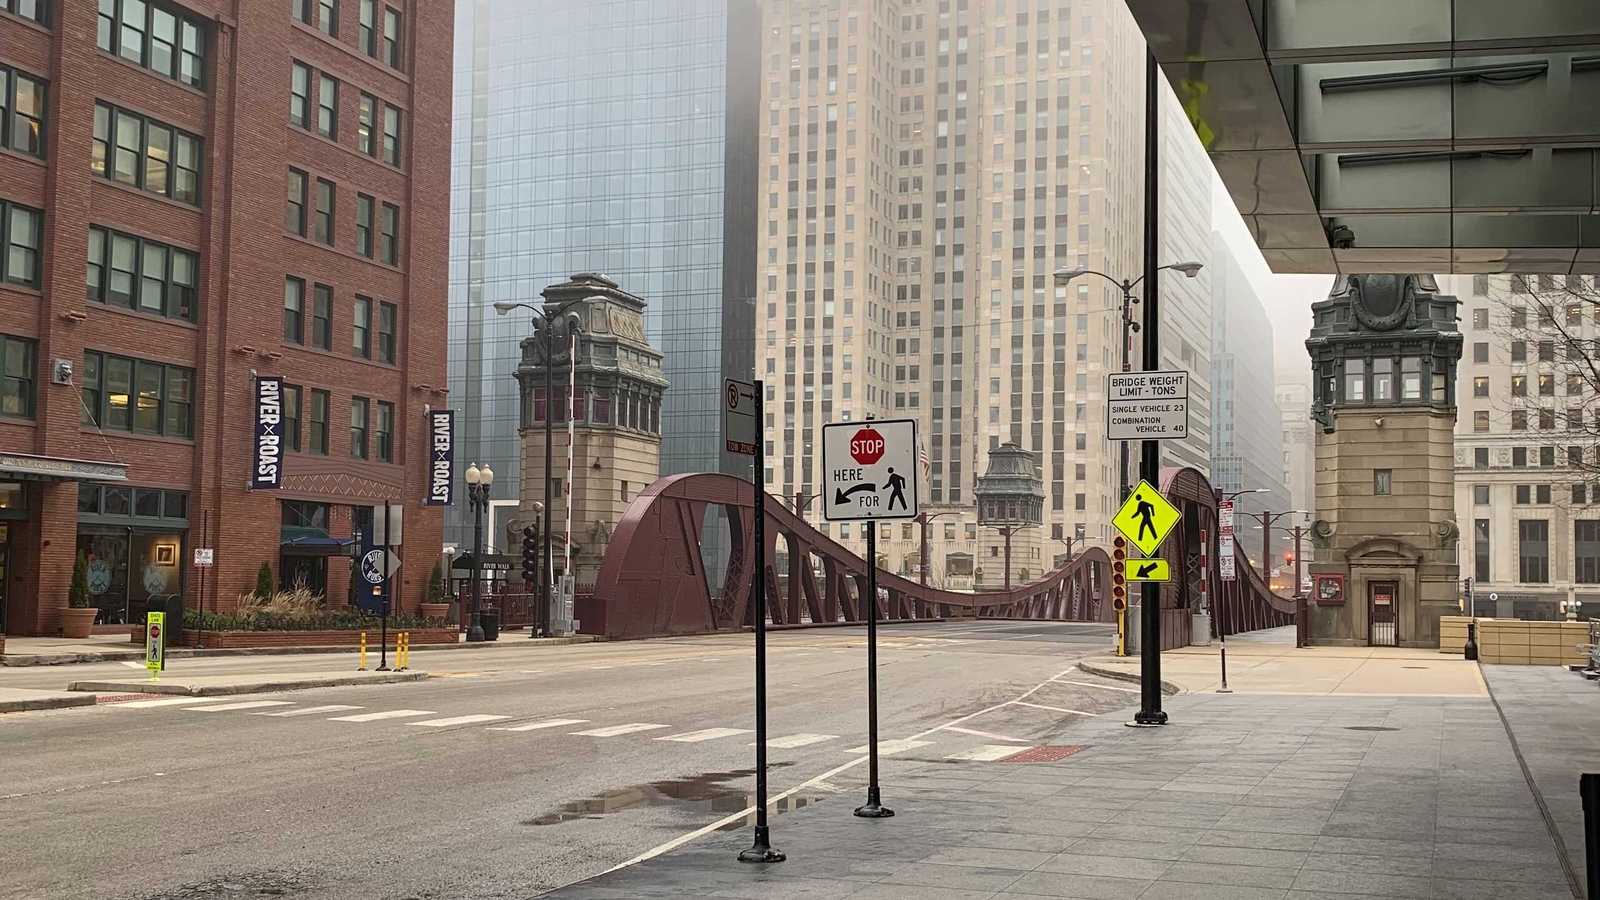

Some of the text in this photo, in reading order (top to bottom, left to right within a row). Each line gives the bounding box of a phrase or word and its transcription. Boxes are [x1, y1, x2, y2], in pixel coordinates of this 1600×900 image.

[1112, 376, 1184, 387] BRIDGE WEIGHT
[1119, 387, 1143, 396] LIMIT
[1152, 386, 1176, 396] TONS
[260, 380, 280, 425] RIVER
[1140, 405, 1171, 413] VEHICLE
[1173, 404, 1184, 412] 23
[1111, 416, 1161, 425] COMBINATION
[433, 413, 450, 452] RIVER
[1135, 424, 1184, 433] VEHICLE 40
[728, 441, 754, 454] TOW ZONE
[851, 439, 884, 455] STOP
[258, 435, 280, 484] ROAST
[432, 460, 450, 503] ROAST
[833, 468, 864, 482] HERE
[859, 495, 880, 508] FOR
